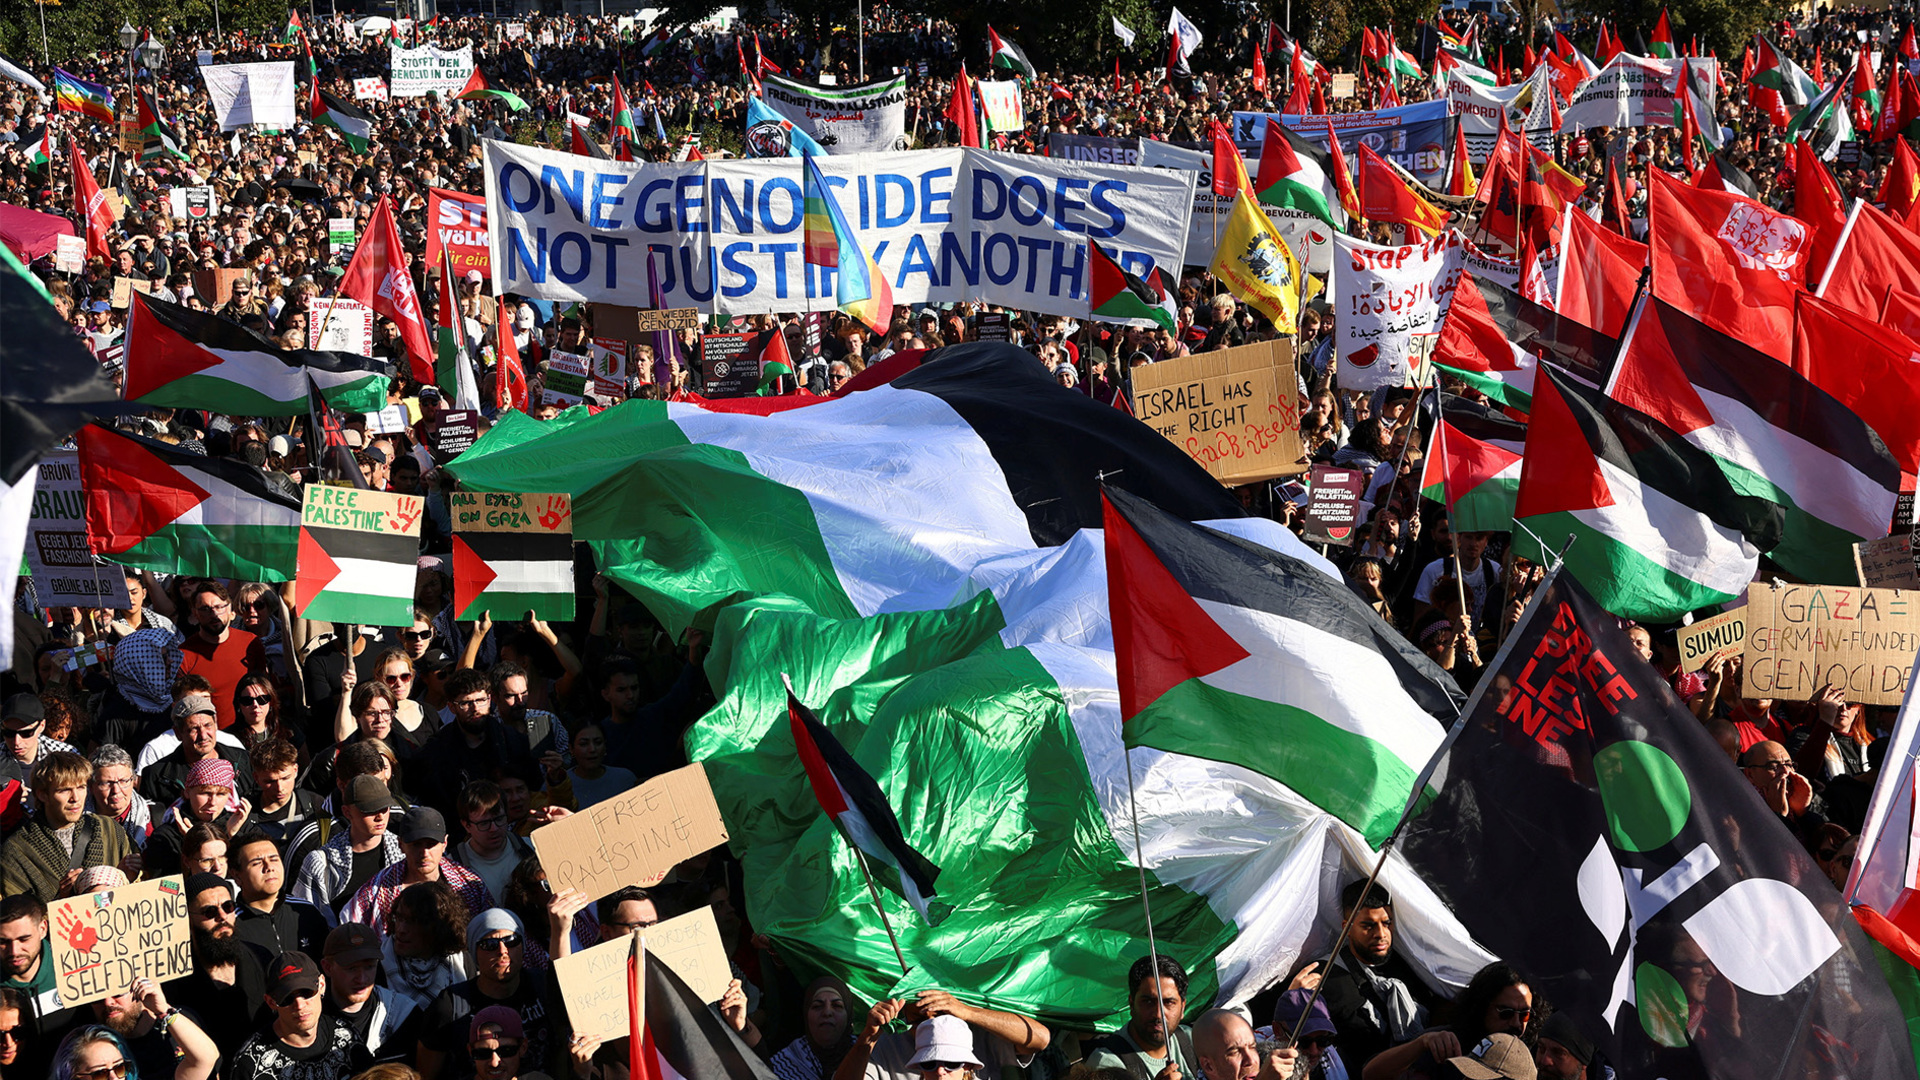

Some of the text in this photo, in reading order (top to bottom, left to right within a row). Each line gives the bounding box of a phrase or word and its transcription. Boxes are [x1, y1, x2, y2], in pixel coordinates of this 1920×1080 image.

[401, 57, 460, 68] STOPPT DEN
[391, 68, 473, 79] GENOZID IN GAZA
[1597, 72, 1663, 86] für Palästina
[768, 87, 813, 108] FREIHEIT
[815, 98, 836, 111] FÜR
[1557, 87, 1676, 110] Soialismus internation
[805, 108, 864, 122] فلسطين حرة
[1301, 115, 1350, 124] Solidaität
[1346, 116, 1400, 127] Bevölkerung!
[500, 161, 628, 228] ONE
[972, 168, 1128, 238] DOES
[1195, 194, 1235, 203] SOLIDA
[438, 228, 489, 247] VÖLK
[465, 254, 488, 266] ein
[507, 228, 630, 290] NOT
[1351, 245, 1412, 272] STOP
[1420, 230, 1459, 262] THE
[332, 302, 366, 310] PIELPLATZ
[639, 308, 697, 321] NIE WIEDER
[311, 310, 319, 335] KINDER
[363, 313, 372, 336] UNTER
[641, 319, 698, 331] GENOZID
[363, 340, 372, 356] BOM
[704, 336, 742, 344] DEUTSCHLAND
[713, 341, 749, 349] MITSCHULDIG
[713, 347, 749, 355] VÖLKERMORD
[550, 360, 588, 376] WIDERSTAND
[1137, 381, 1252, 420] ISRAEL HAS
[1157, 403, 1248, 436] THE RIGHT
[441, 429, 475, 437] PALÄSTINA!
[1186, 394, 1300, 470] fuck itself
[309, 487, 358, 508] FREE
[452, 492, 523, 509] ALL EYES
[305, 504, 385, 532] PALESTINE
[460, 510, 532, 528] ON GAZA
[39, 534, 69, 548] GEGEN
[45, 549, 92, 564] FASCHISM
[51, 576, 113, 593] GRÜNE RAUS!
[1781, 587, 1880, 623] GAZA
[1684, 620, 1745, 659] SUMUD
[1751, 625, 1920, 653] GERMAN-FUNDED
[1552, 601, 1638, 716] FREE
[1750, 657, 1915, 693] GENOCIDE
[592, 787, 663, 835] FREE
[557, 815, 693, 893] PALESTINE
[162, 879, 179, 890] FREE
[95, 892, 188, 942] BOMBING
[60, 923, 174, 975] KIDS IS NOT
[586, 920, 707, 975] KINDMÖRDER
